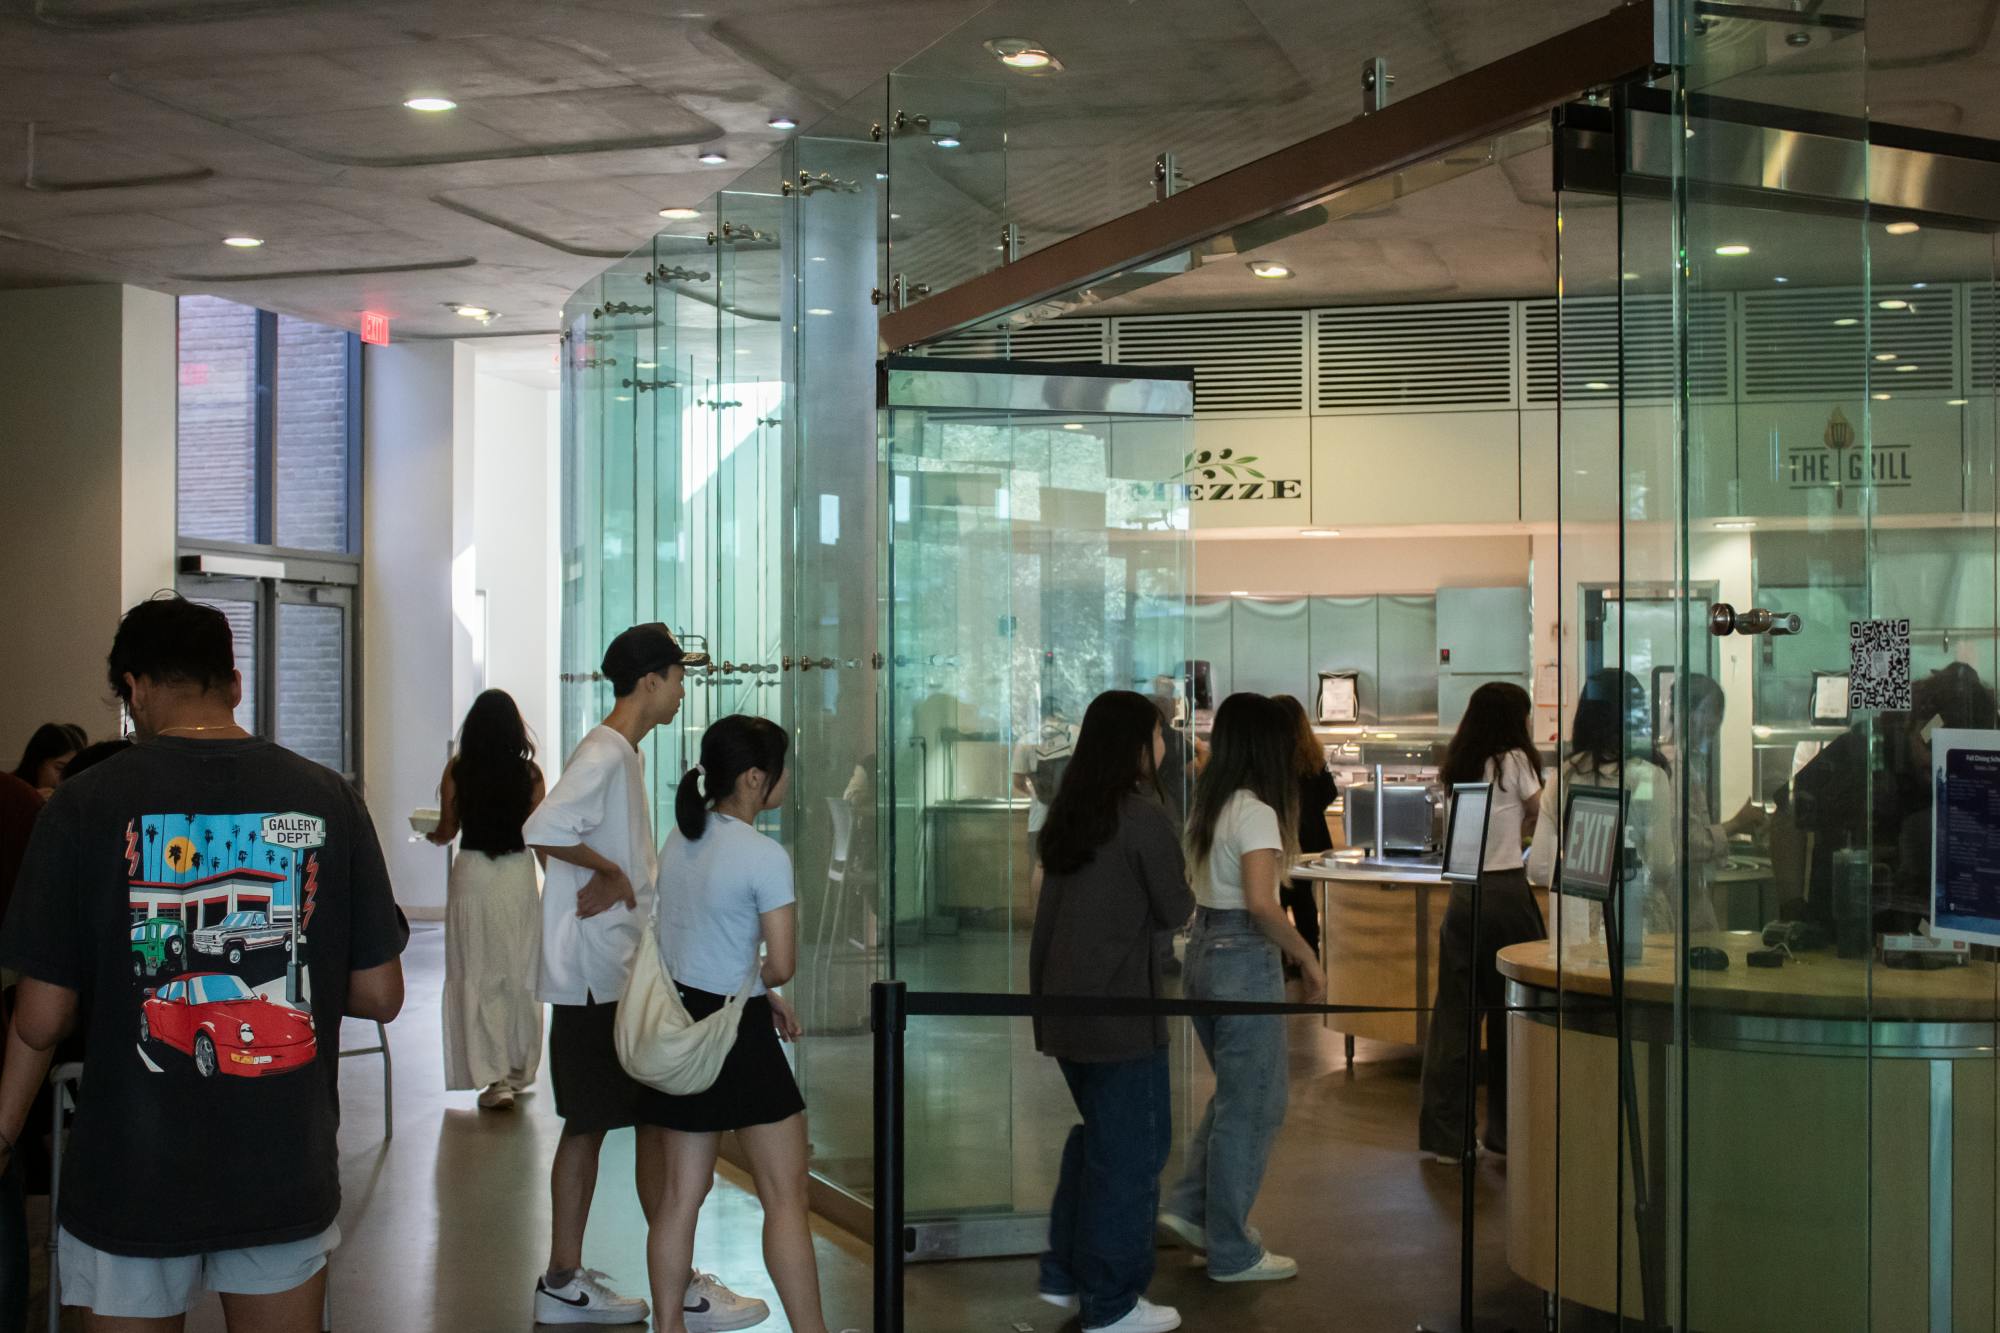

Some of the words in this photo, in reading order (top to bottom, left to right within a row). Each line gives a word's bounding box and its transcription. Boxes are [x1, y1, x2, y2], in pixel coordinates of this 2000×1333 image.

[366, 314, 384, 341] EXIT
[1789, 453, 1829, 482] THE
[1849, 451, 1911, 481] GRILL
[269, 818, 317, 832] GALLERY
[277, 832, 313, 844] DEPT.
[1566, 811, 1616, 876] EXIT
